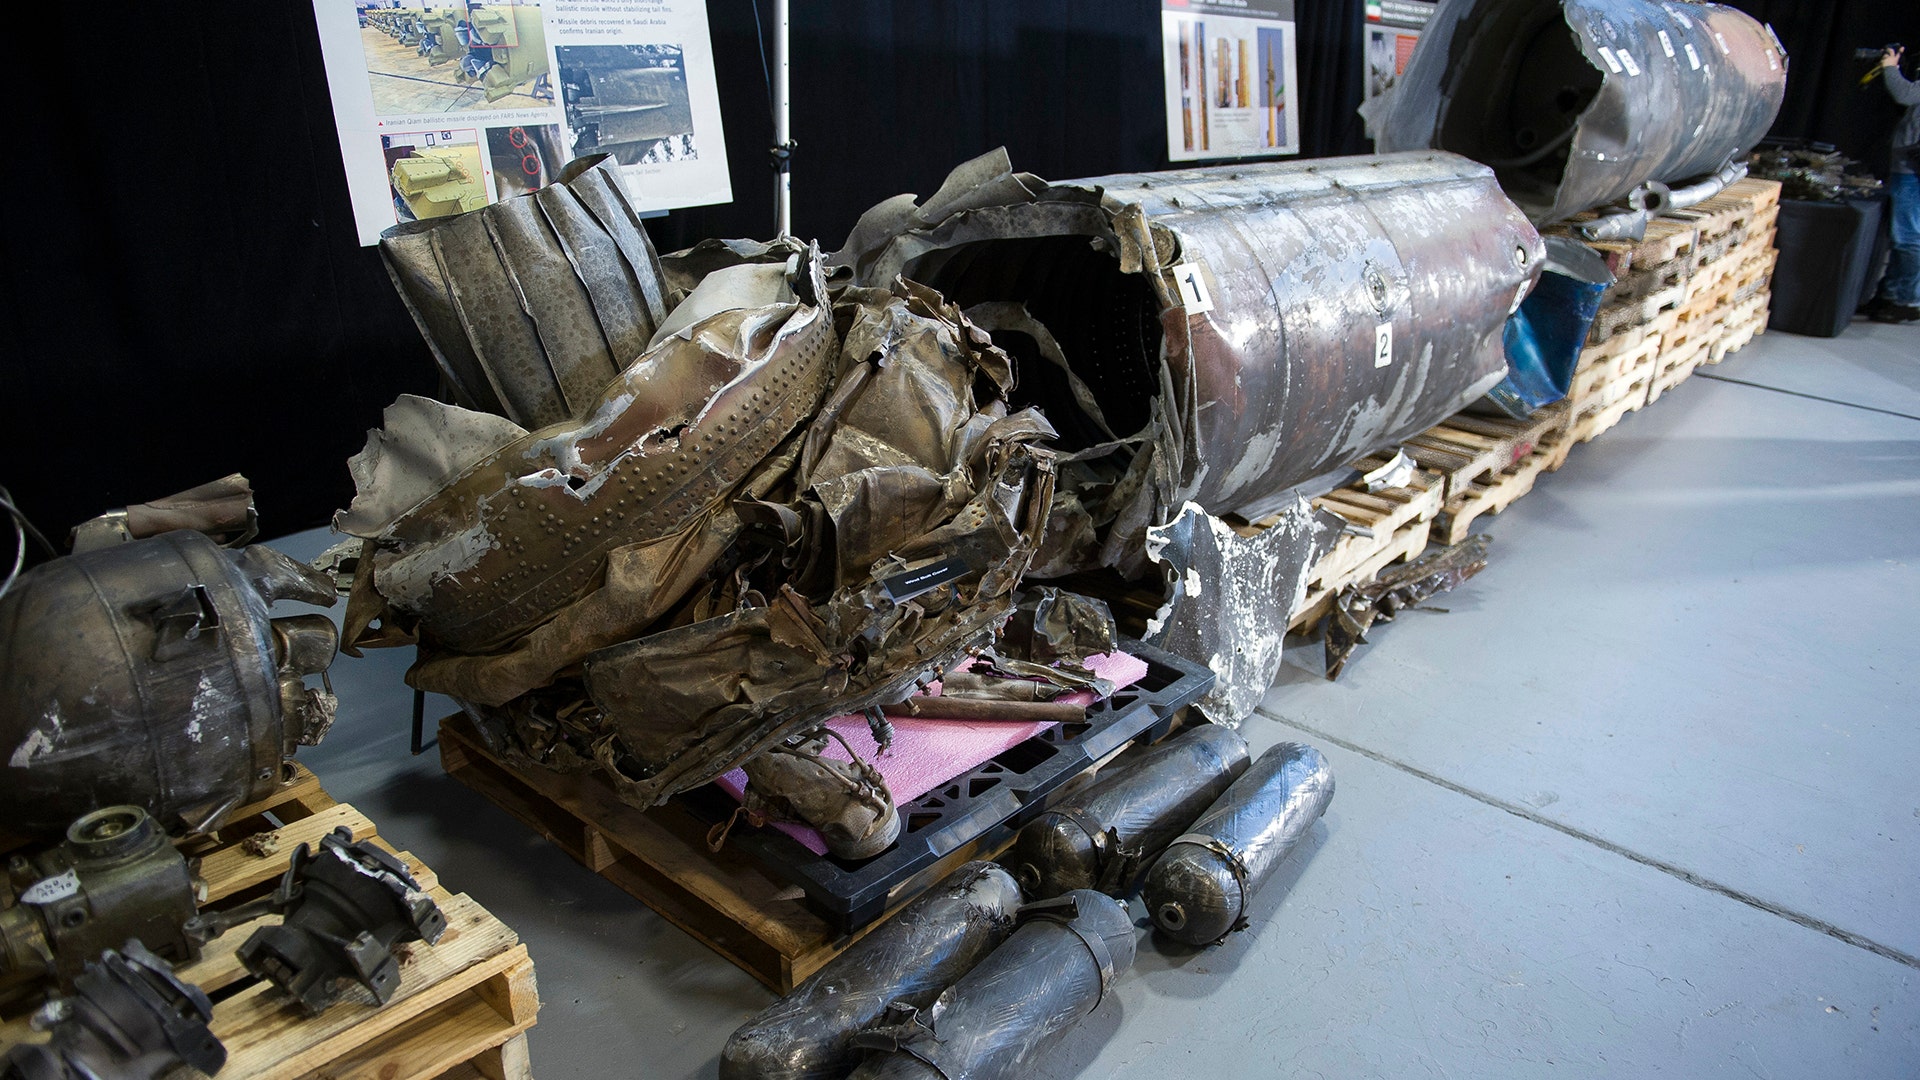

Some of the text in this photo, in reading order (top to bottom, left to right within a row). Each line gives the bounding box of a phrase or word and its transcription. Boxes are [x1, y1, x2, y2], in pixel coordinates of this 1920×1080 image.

[423, 116, 446, 124] ballistic
[467, 114, 492, 123] displayed
[530, 111, 549, 119] Agency
[1185, 272, 1202, 303] 1
[1380, 332, 1388, 359] 2
